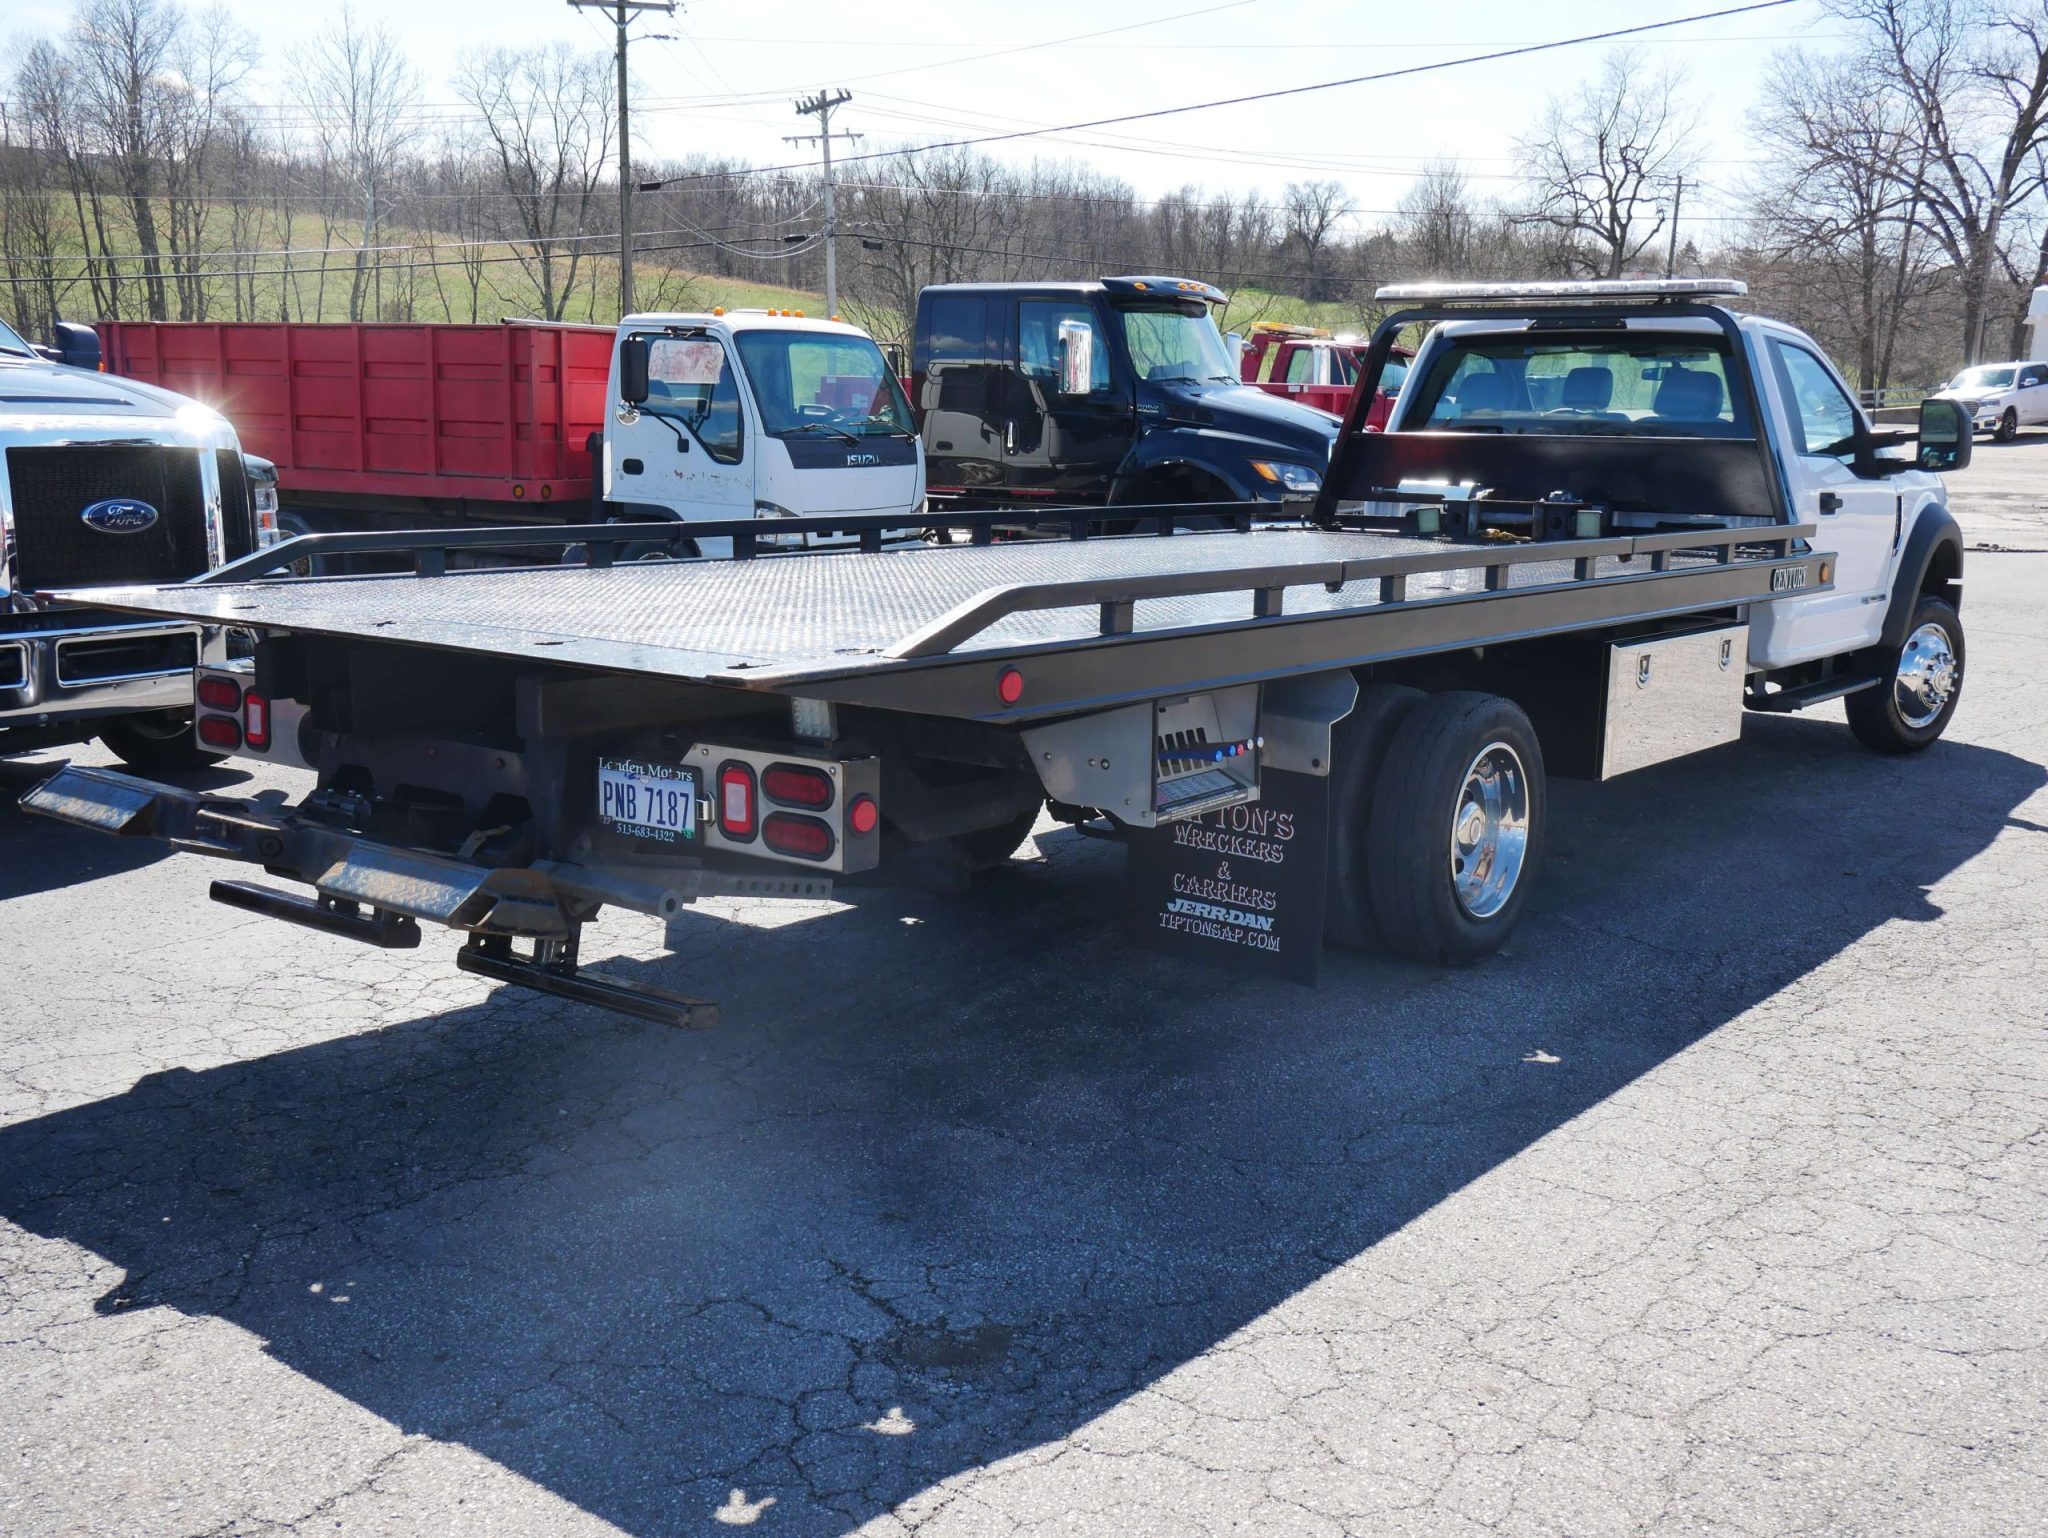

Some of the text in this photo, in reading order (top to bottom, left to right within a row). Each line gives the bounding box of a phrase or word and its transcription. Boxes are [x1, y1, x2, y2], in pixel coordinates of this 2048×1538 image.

[847, 454, 880, 466] ISUZU
[104, 505, 145, 526] Ford
[1773, 565, 1809, 591] CENTURY
[603, 780, 690, 830] PNB 7187
[1174, 823, 1284, 864] WRECKERS
[1217, 861, 1232, 880] &
[1173, 873, 1277, 911] CARRIERS
[1159, 912, 1281, 952] TIPTONSAP.COM
